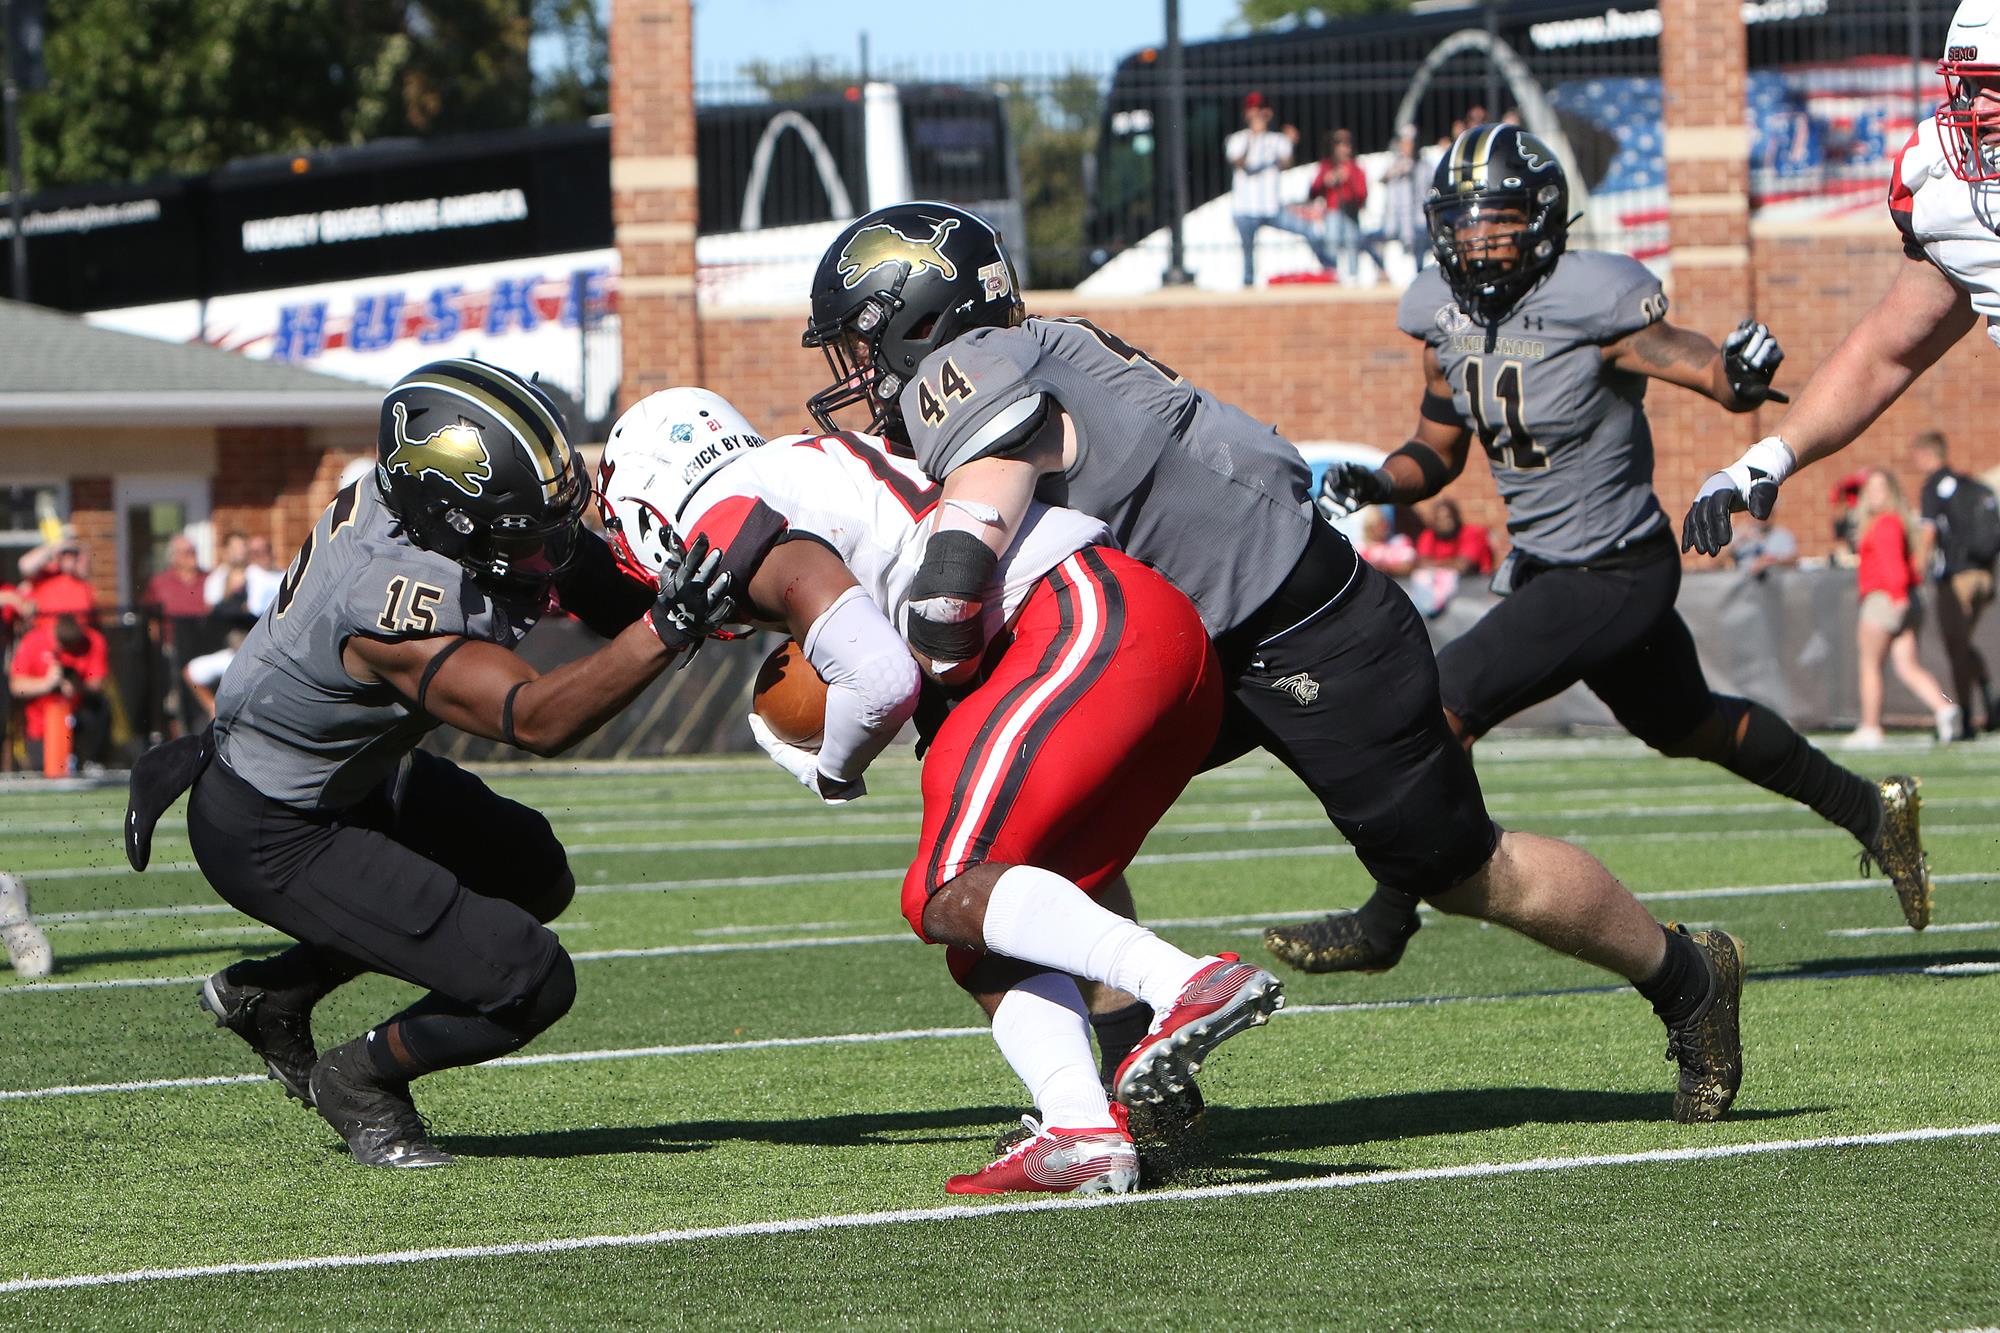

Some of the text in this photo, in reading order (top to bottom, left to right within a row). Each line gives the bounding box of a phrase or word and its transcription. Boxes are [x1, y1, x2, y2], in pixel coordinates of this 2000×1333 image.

[1948, 45, 1977, 61] SEMO
[272, 266, 608, 362] HUSKE
[917, 357, 976, 428] 44
[1462, 356, 1549, 471] 11
[707, 419, 722, 432] 21
[721, 434, 741, 451] BY
[376, 574, 445, 632] 15
